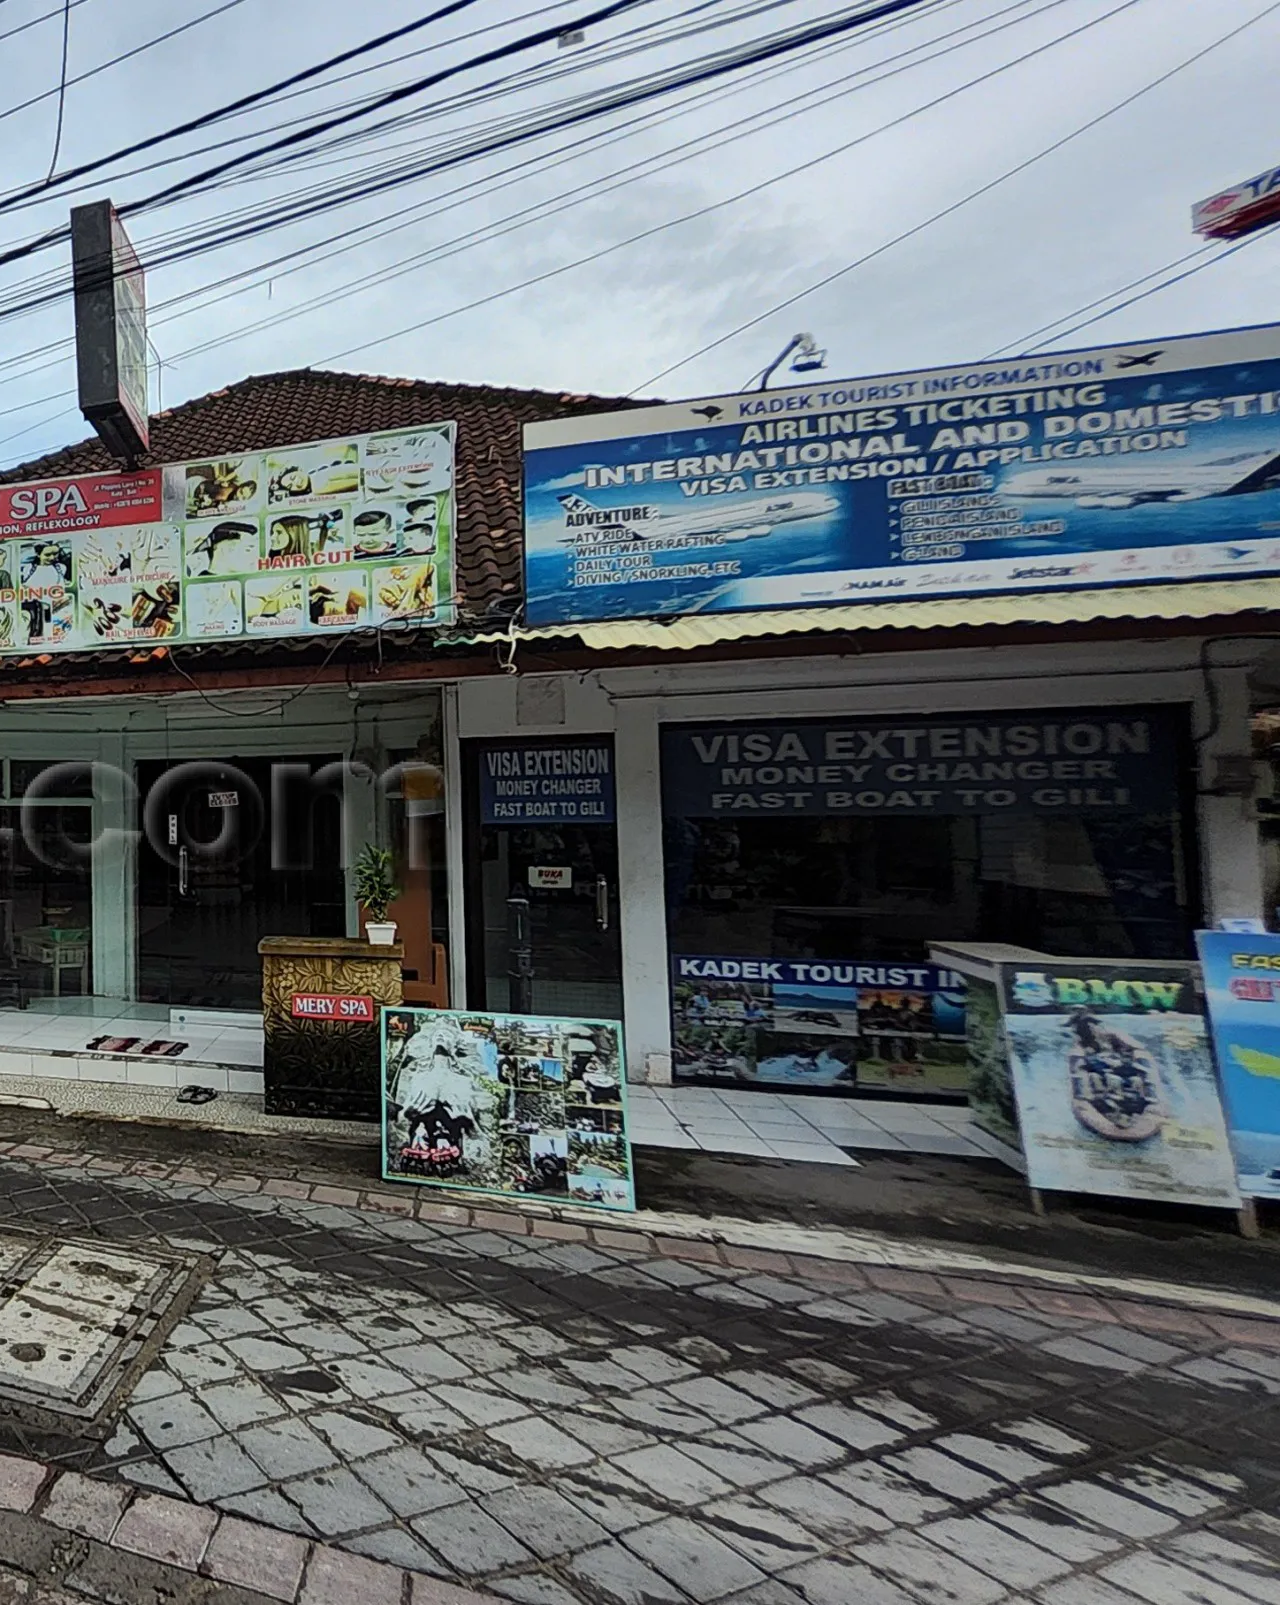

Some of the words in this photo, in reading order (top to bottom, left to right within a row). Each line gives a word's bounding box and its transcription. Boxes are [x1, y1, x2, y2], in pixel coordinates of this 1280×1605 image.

[738, 393, 816, 417] KADEK
[819, 377, 918, 406] TOURIST
[922, 358, 1105, 395] INFORMATION
[739, 406, 899, 447] AIRLINES
[903, 384, 1107, 427] TICKETING
[583, 430, 918, 490] INTERNATIONAL
[928, 419, 1033, 453] AND
[1043, 390, 1280, 440] DOMESTI
[680, 475, 748, 498] VISA
[754, 454, 927, 491] EXTENSION
[951, 430, 1189, 471] APPLICATION
[9, 484, 88, 519] SPA
[25, 515, 101, 531] REFLEXOLOGY
[566, 507, 651, 528] ADVENTURE
[575, 531, 599, 543] ATV
[602, 529, 633, 541] RIDE
[576, 543, 618, 558] WHITE
[620, 540, 665, 554] WATER
[666, 535, 726, 550] RAFTING
[258, 554, 308, 571] HAIR
[313, 550, 355, 564] CUT
[576, 558, 612, 572] DAILY
[615, 555, 652, 569] TOUR
[576, 572, 622, 586] DIVING
[692, 732, 810, 764] VISA
[825, 720, 1152, 762] EXTENSION
[487, 752, 522, 777] VISA
[524, 749, 610, 776] EXTENSION
[722, 764, 873, 786] MONEY
[885, 760, 1119, 783] CHANGER
[496, 780, 538, 797] MONEY
[541, 778, 602, 796] CHANGER
[712, 790, 813, 810] FAST
[827, 789, 943, 809] BOAT
[950, 789, 1007, 808] TO
[1031, 787, 1132, 807] GILI
[494, 802, 523, 817] FAST
[525, 801, 558, 816] BOAT
[560, 801, 578, 816] TO
[580, 801, 605, 816] GILI
[538, 869, 563, 878] BUKA
[679, 959, 783, 982] KADEK
[790, 963, 927, 988] TOURIST
[295, 997, 337, 1014] MERY
[339, 999, 369, 1016] SPA
